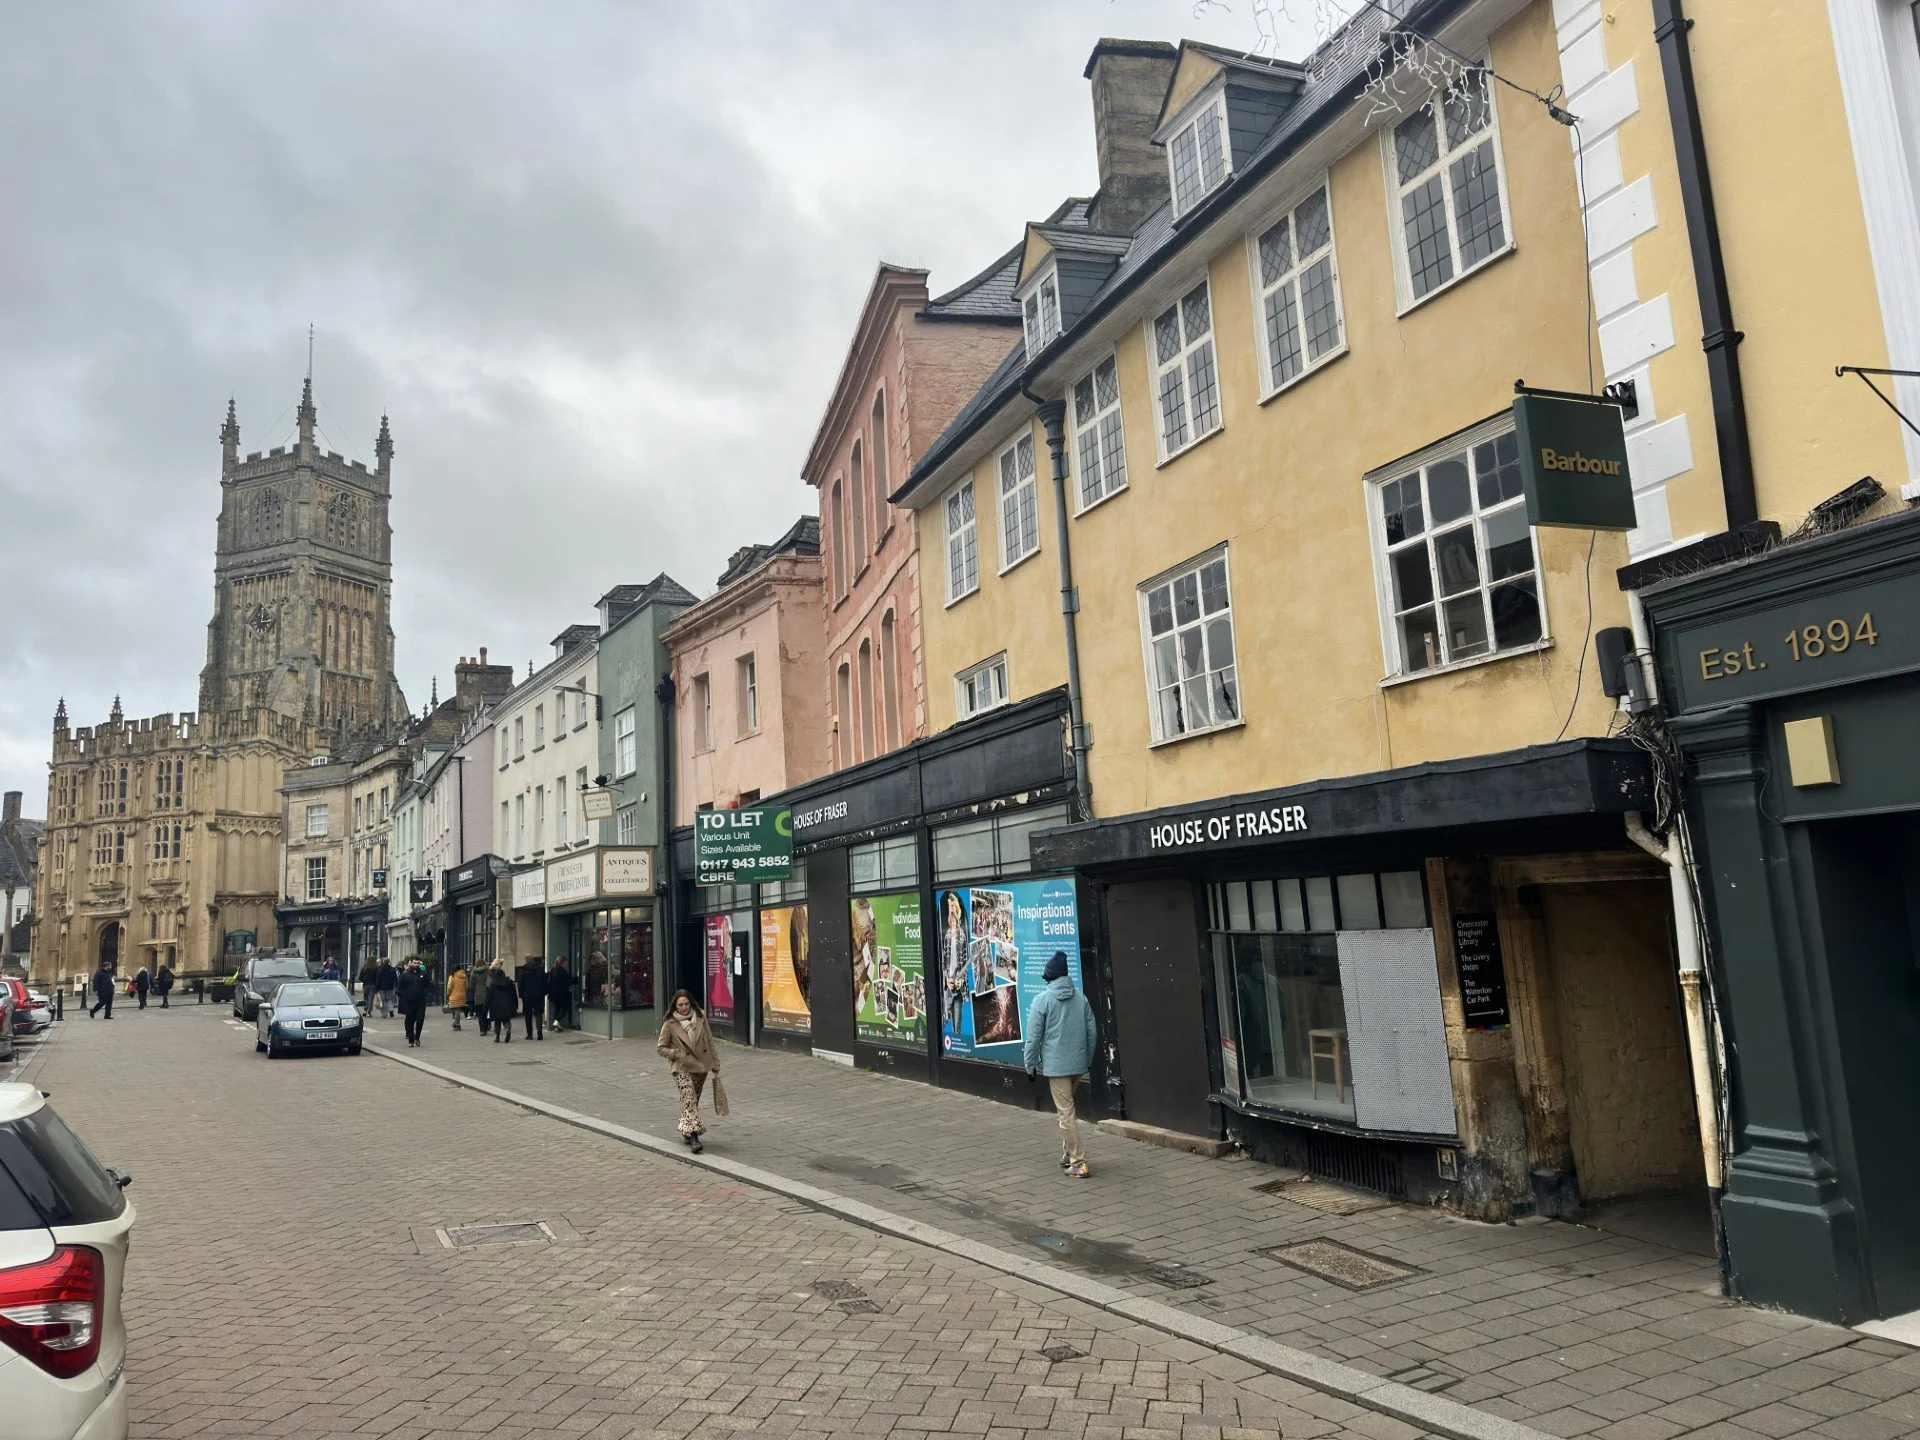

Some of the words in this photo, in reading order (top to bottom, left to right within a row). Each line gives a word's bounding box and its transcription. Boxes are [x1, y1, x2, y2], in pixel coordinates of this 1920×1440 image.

[1541, 447, 1621, 477] Barbour
[1699, 641, 1767, 681] Est.
[1785, 612, 1879, 662] 1894
[700, 813, 726, 829] TO
[731, 811, 763, 828] LET
[793, 811, 814, 830] HOUSE
[814, 809, 824, 824] OF
[824, 801, 848, 822] FRASER
[1150, 819, 1205, 849] HOUSE
[1207, 815, 1231, 841] OF
[1235, 805, 1308, 837] FRASER
[700, 832, 731, 842] Various
[733, 832, 750, 841] Unit
[700, 846, 724, 855] Sizes
[725, 843, 761, 853] Available
[606, 858, 647, 866] ANTIQUES
[700, 859, 728, 871] 0117
[732, 858, 755, 868] 943
[758, 855, 790, 867] 5852
[700, 872, 735, 882] CBRE
[1017, 901, 1074, 922] Inspirational
[892, 911, 920, 925] Individual
[1042, 920, 1075, 935] Events
[1456, 920, 1489, 929] Cirencester
[904, 926, 921, 939] Food
[1457, 930, 1483, 938] Bingham
[1458, 938, 1479, 946] Library
[1460, 954, 1472, 962] The
[1472, 953, 1490, 962] Livery
[1462, 963, 1479, 972] shops
[1464, 979, 1475, 987] The
[1465, 987, 1492, 996] Waterloo
[1466, 996, 1477, 1004] Car
[1477, 995, 1491, 1003] Park
